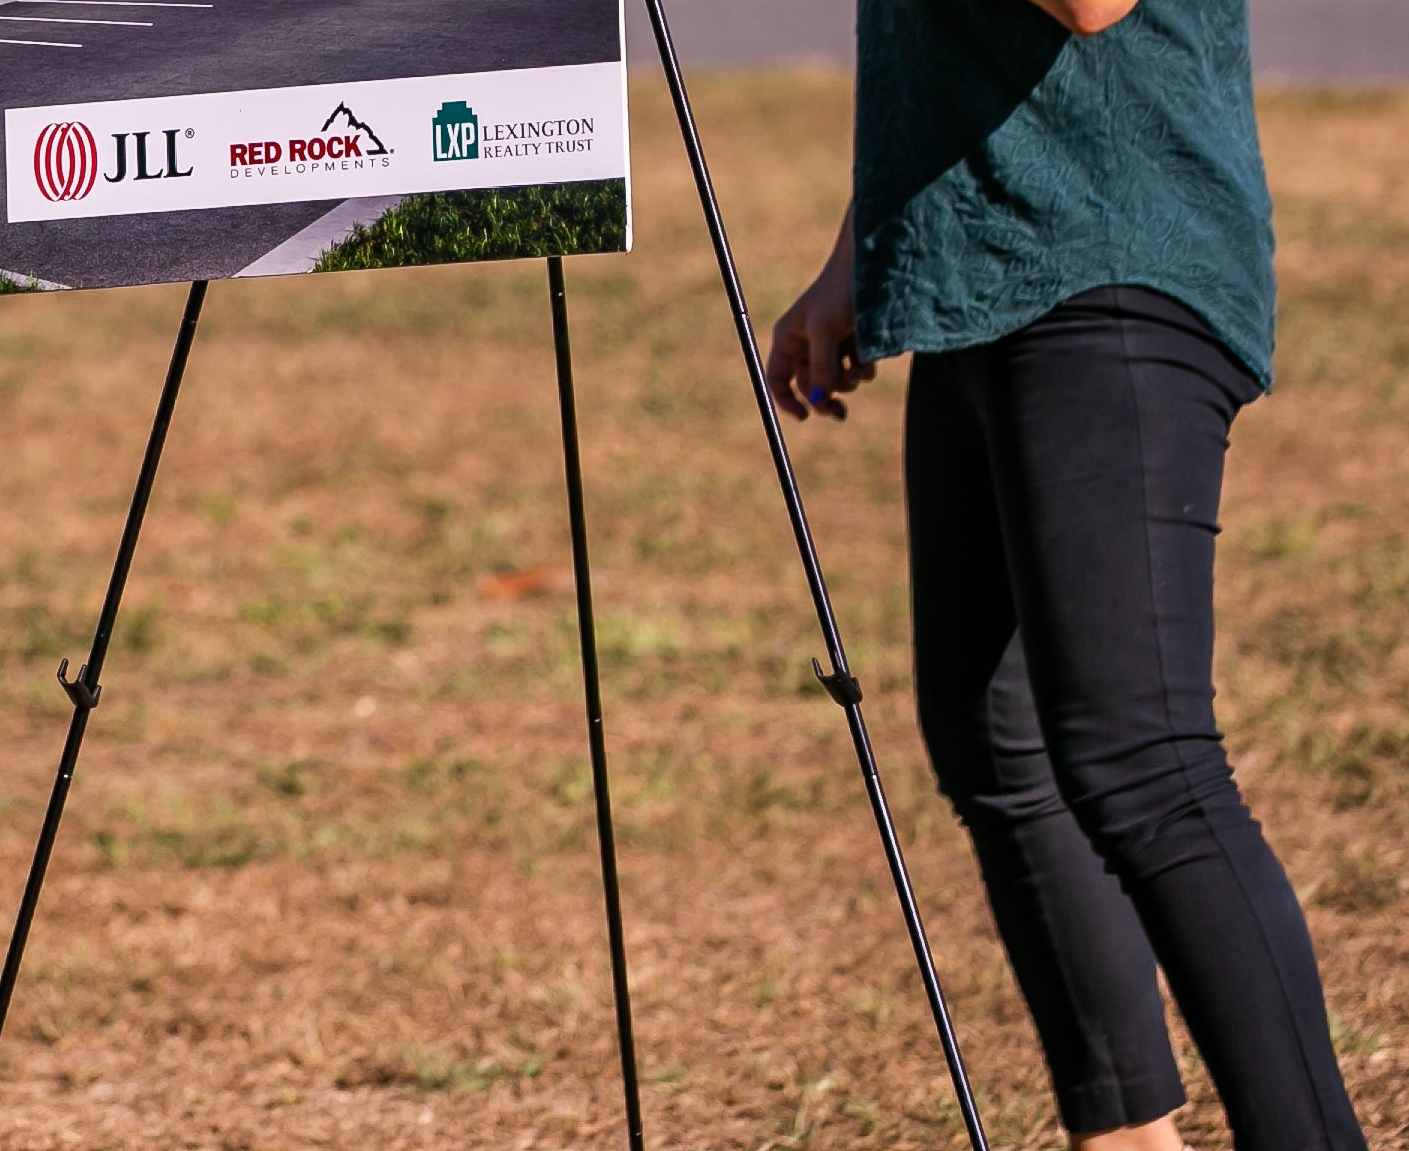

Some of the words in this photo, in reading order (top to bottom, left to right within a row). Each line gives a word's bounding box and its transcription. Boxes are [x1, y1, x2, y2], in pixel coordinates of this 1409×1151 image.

[435, 122, 476, 159] LXP
[483, 118, 595, 142] LEXINGTON
[230, 141, 282, 167] RED
[289, 135, 363, 162] ROCK
[483, 143, 542, 159] REALTY
[545, 139, 594, 154] TRUST
[230, 157, 391, 179] DEVELOPMENTS
